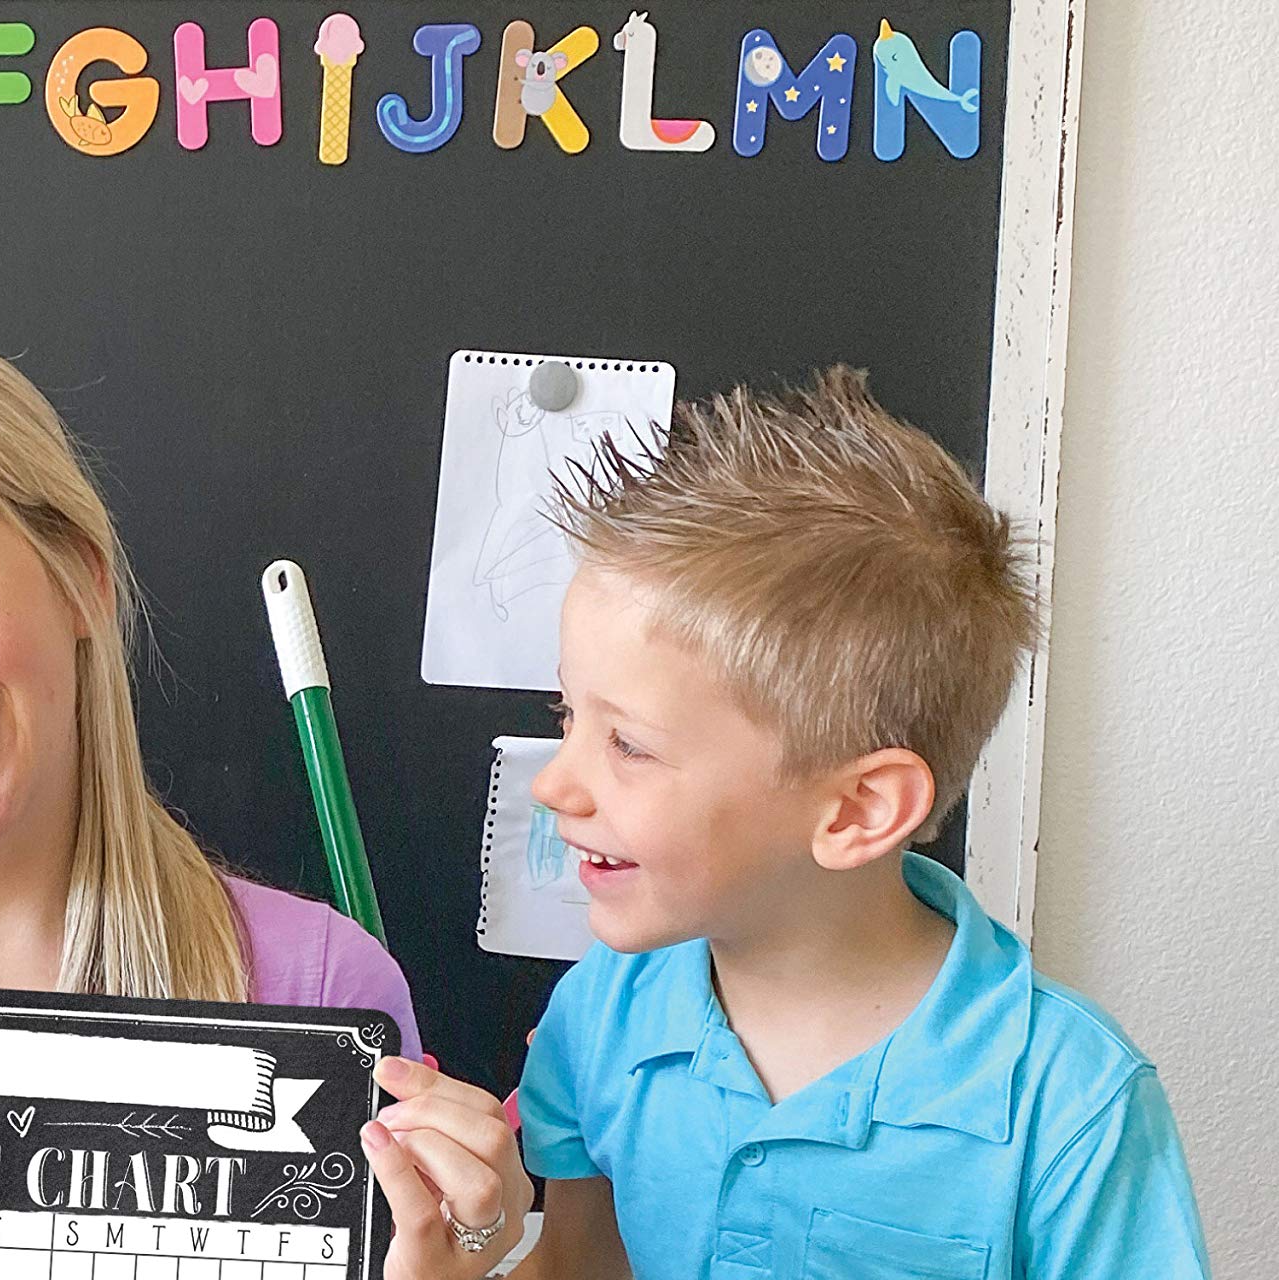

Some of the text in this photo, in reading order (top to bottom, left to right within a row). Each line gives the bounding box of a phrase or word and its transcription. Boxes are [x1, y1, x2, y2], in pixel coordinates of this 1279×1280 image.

[24, 1145, 247, 1216] CHART
[65, 1221, 80, 1247] S
[104, 1224, 125, 1249] M
[152, 1226, 166, 1250] T
[190, 1228, 210, 1253] W
[236, 1229, 249, 1255] T
[278, 1232, 290, 1257] F
[320, 1234, 335, 1259] S
